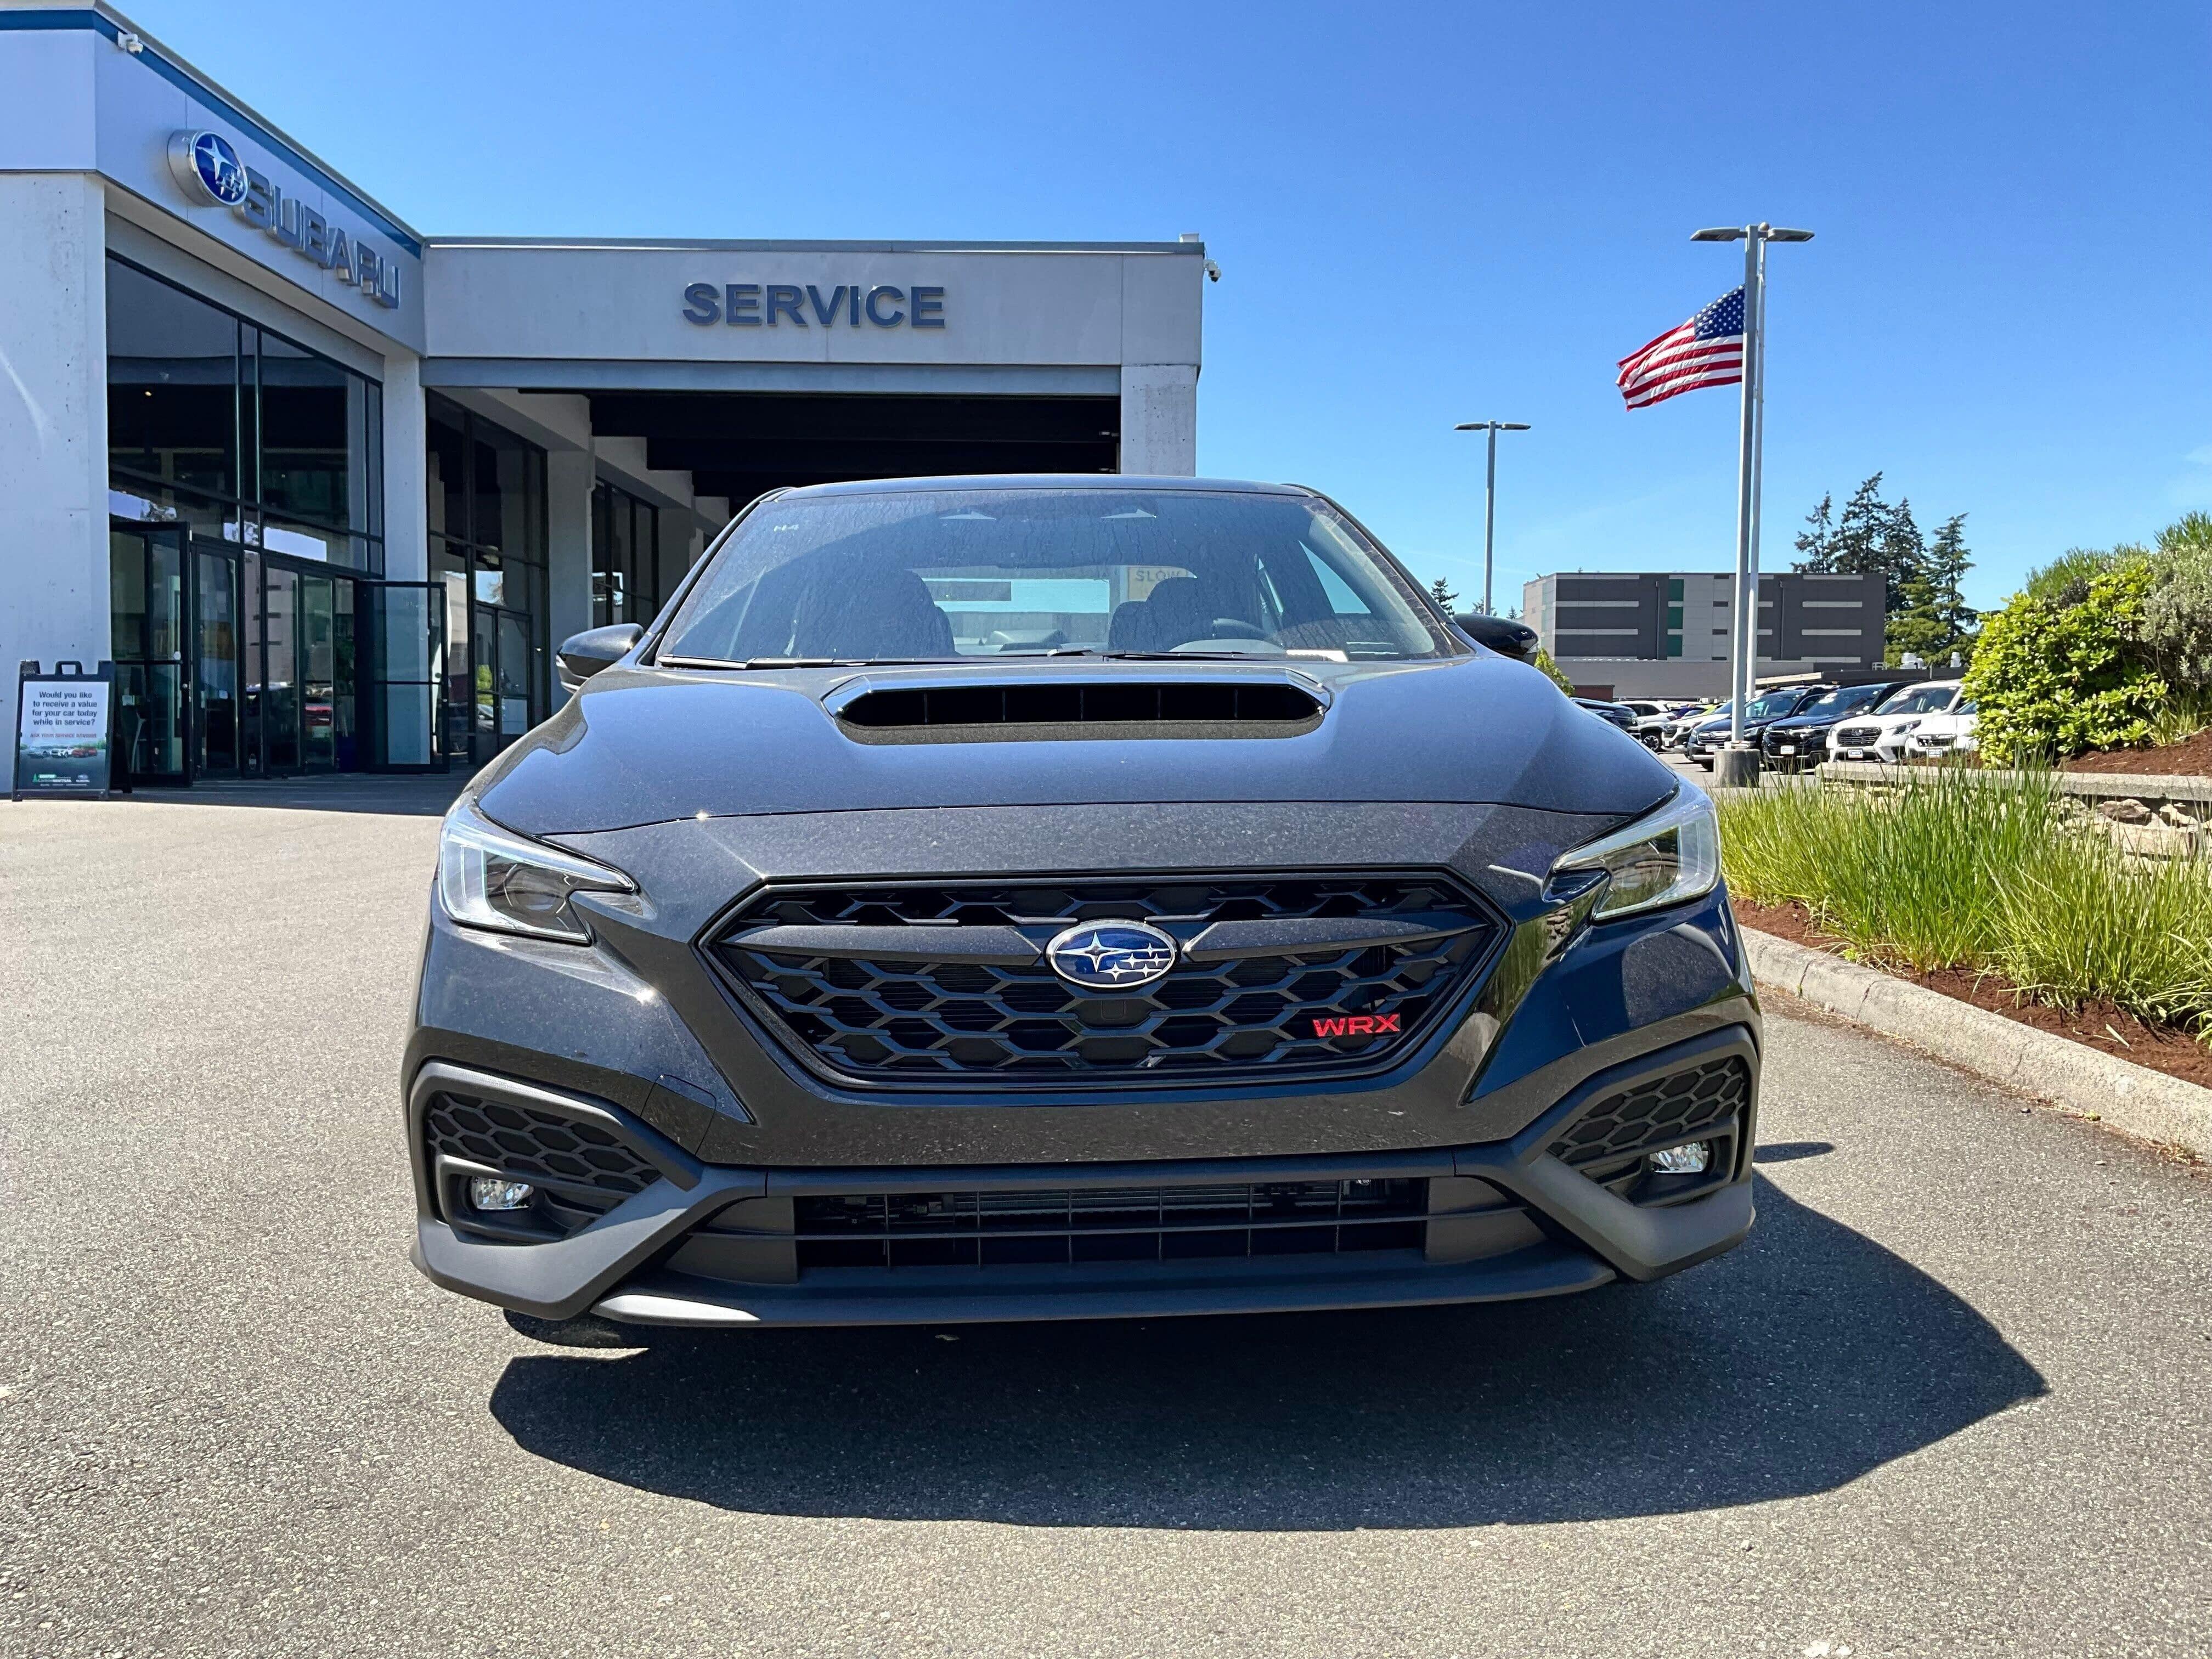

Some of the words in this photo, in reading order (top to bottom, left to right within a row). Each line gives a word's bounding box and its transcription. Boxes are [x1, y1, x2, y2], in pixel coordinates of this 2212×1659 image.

[240, 166, 400, 309] SUBARU
[682, 283, 945, 329] SERVICE
[77, 709, 97, 718] today
[1313, 1014, 1400, 1037] WRX
